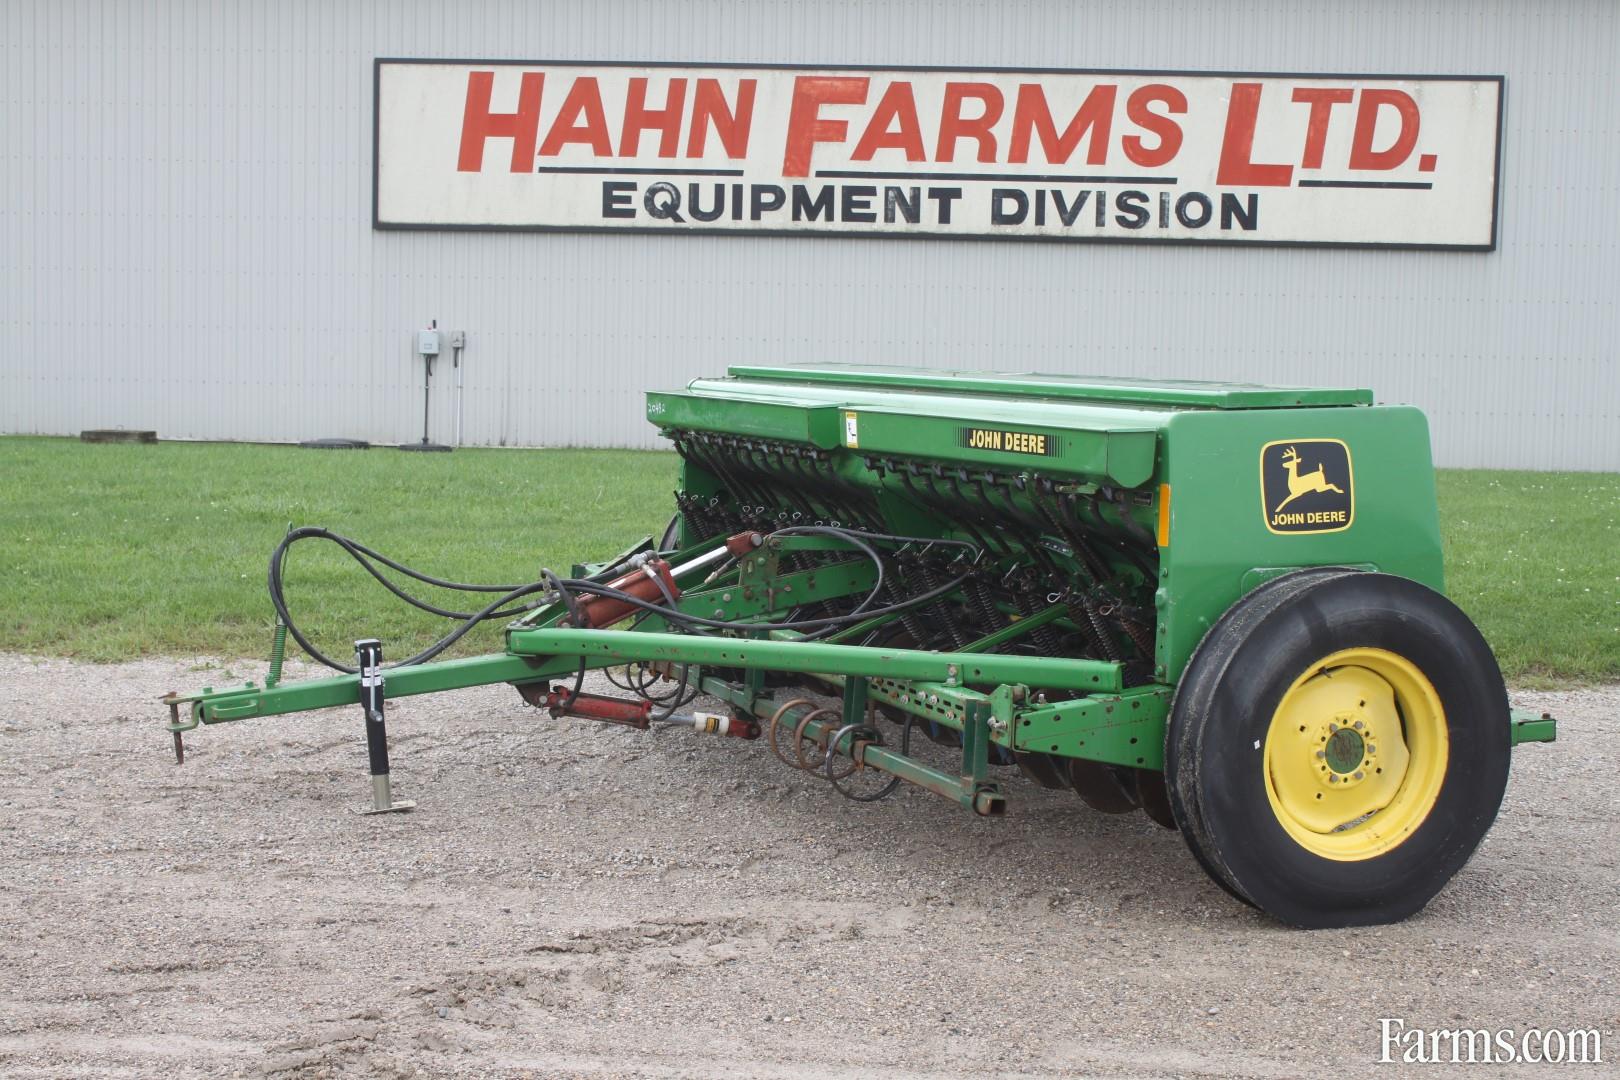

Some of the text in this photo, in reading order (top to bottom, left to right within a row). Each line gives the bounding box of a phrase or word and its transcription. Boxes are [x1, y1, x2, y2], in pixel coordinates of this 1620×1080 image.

[457, 71, 1438, 187] HAHN FARMS LTD.
[602, 181, 1259, 231] EQUIPMENT DIVISION
[969, 429, 1045, 454] JOHN DEERE
[1271, 511, 1346, 526] JOHN DEERE
